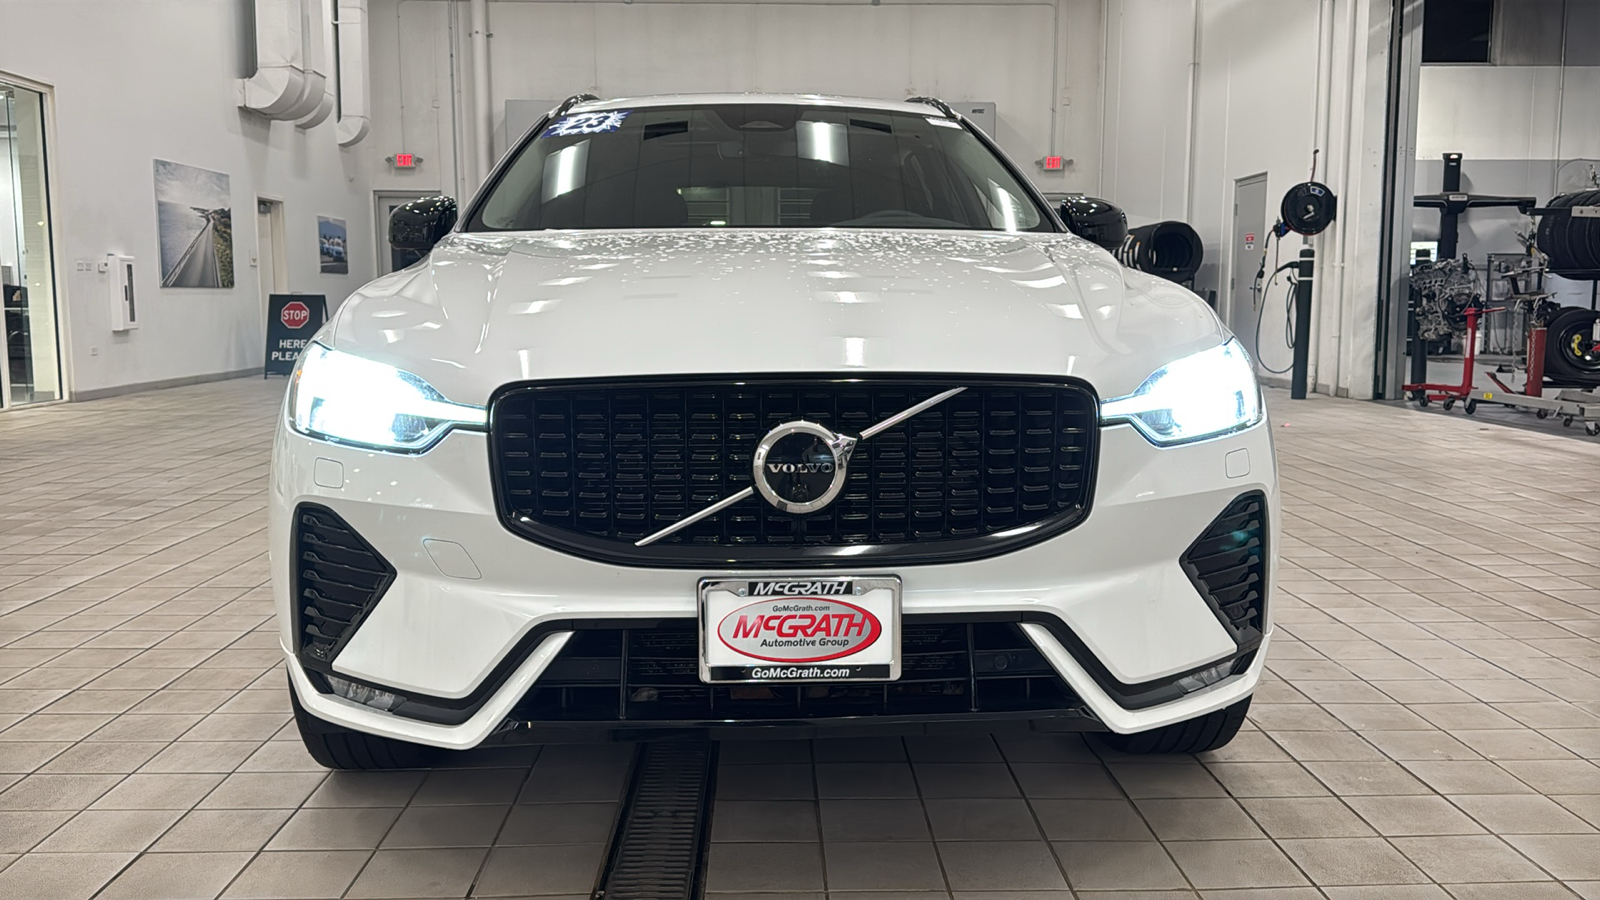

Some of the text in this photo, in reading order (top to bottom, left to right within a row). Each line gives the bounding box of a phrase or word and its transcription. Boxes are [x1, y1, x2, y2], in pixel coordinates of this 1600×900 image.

[565, 115, 611, 130] 23
[397, 154, 412, 166] EXIT
[1046, 156, 1061, 168] EXIT
[283, 310, 308, 320] STOP
[279, 339, 307, 349] HERE
[271, 351, 301, 361] PLEA
[767, 463, 834, 473] VOLVO
[760, 638, 849, 647] Automotive Group
[751, 667, 850, 678] GoMcGrath.com
